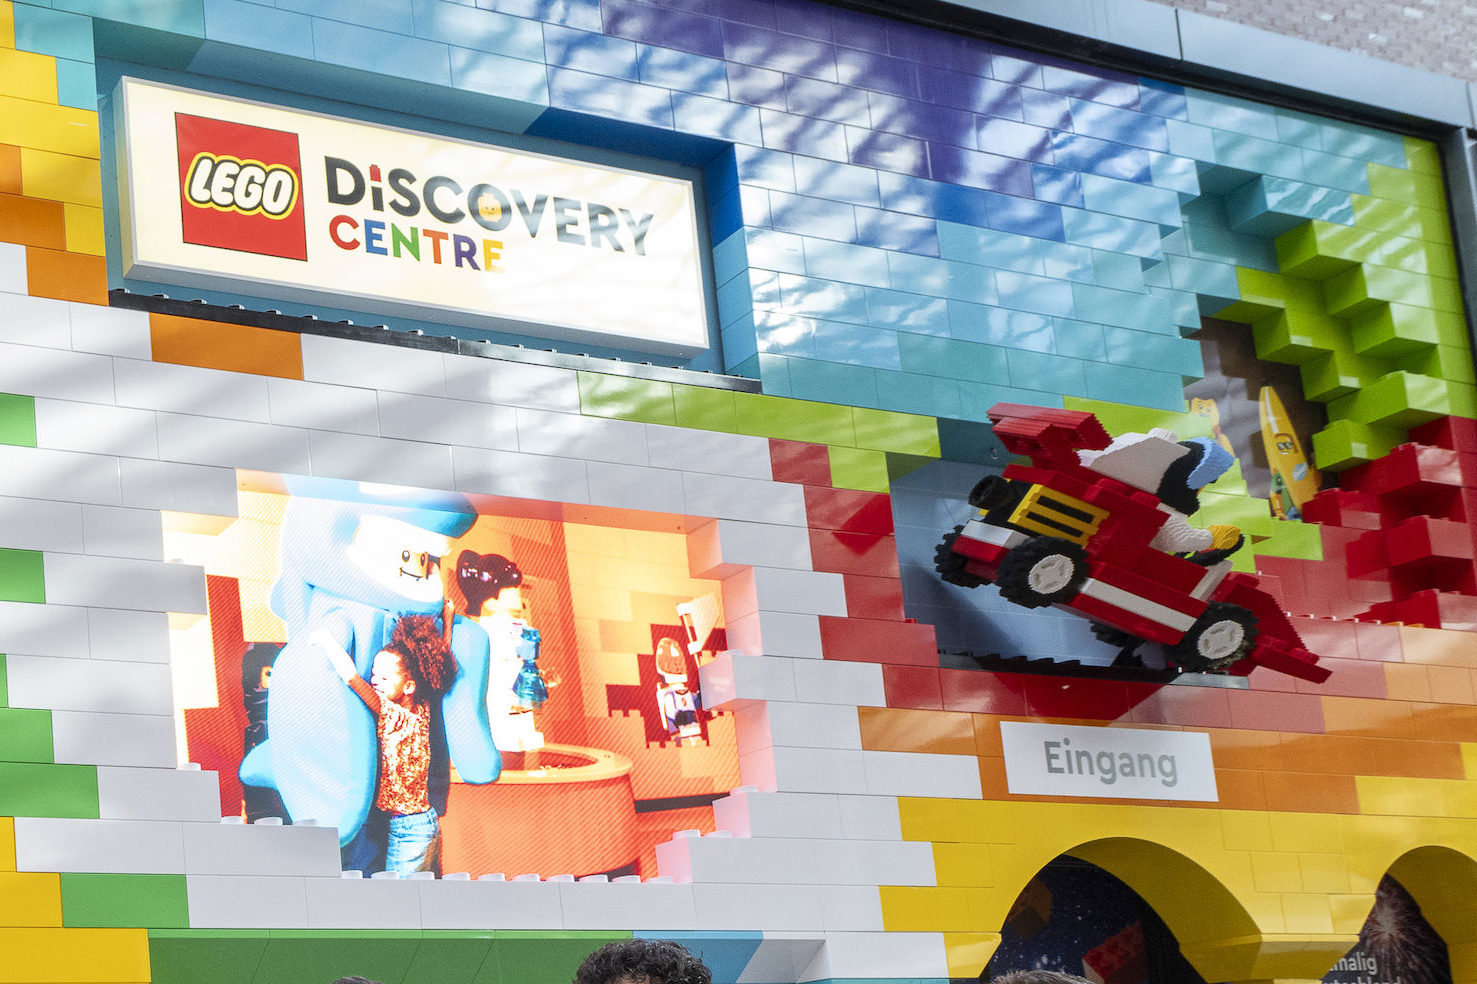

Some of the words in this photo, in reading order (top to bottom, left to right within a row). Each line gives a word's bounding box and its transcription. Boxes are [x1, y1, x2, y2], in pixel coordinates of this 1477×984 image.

[186, 154, 297, 218] LEGO
[328, 214, 506, 274] CENTRE
[1043, 737, 1179, 788] Eingang
[1330, 951, 1377, 976] malig
